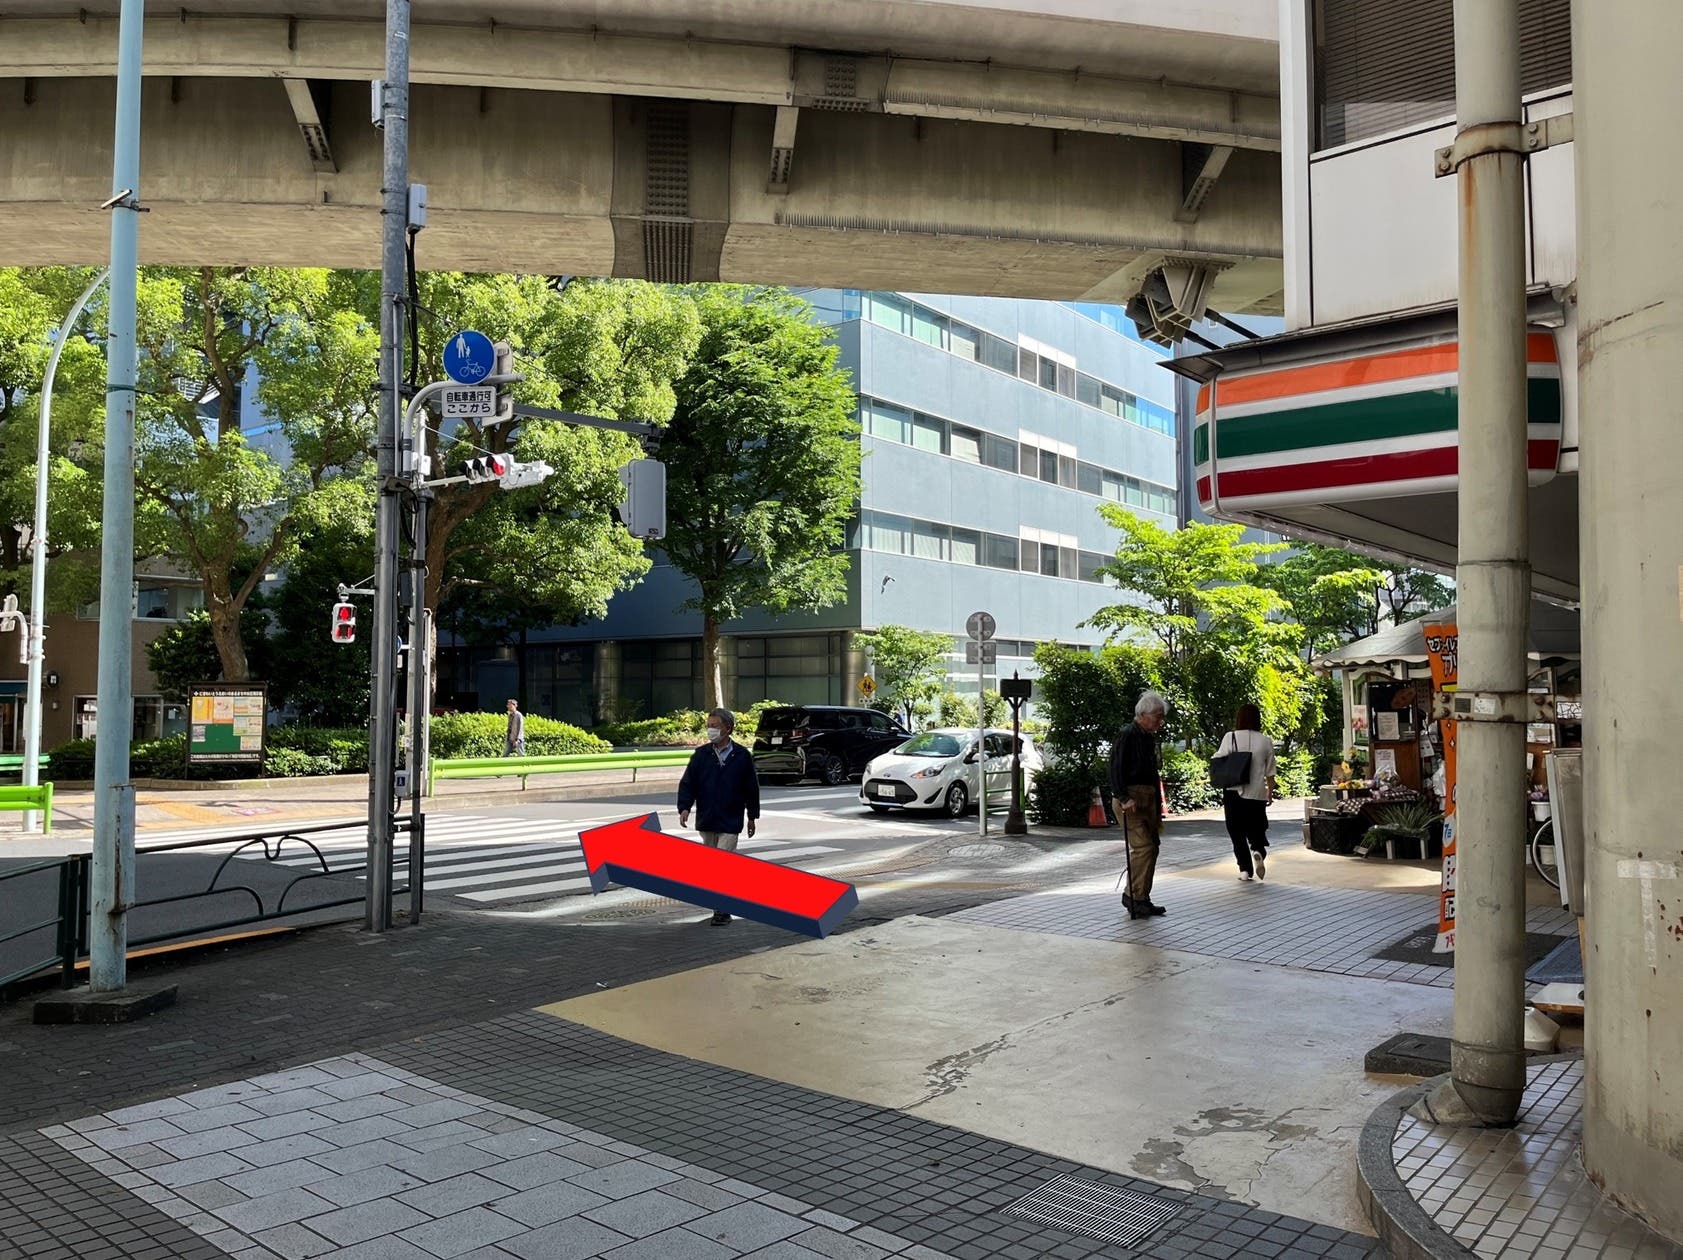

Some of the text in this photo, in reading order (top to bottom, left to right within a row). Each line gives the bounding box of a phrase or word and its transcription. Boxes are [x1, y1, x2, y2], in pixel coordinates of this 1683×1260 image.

[446, 390, 492, 402] 自転車通行可
[447, 403, 491, 413] ここから
